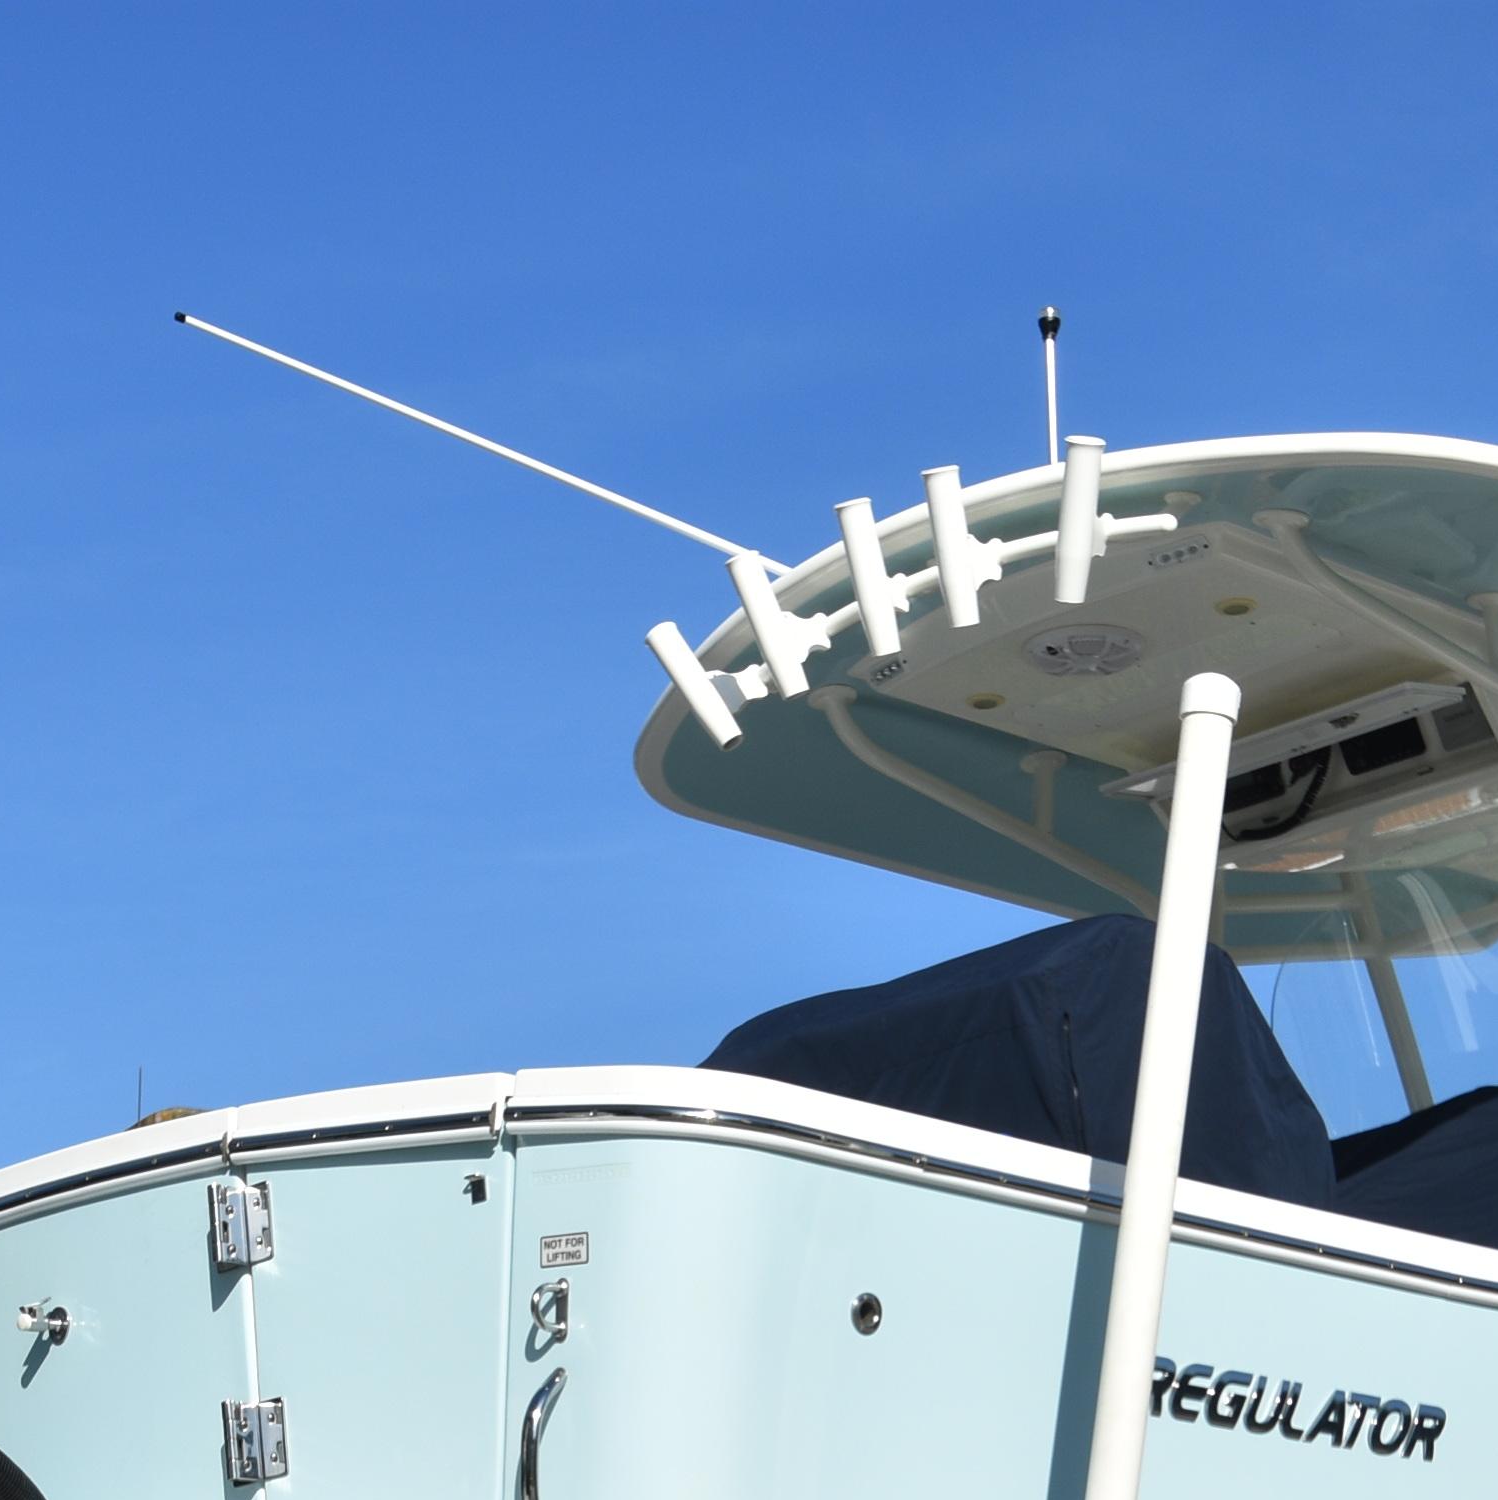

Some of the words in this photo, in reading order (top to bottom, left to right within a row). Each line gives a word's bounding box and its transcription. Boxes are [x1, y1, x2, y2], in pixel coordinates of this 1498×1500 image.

[544, 1239, 562, 1250] NOT
[565, 1236, 584, 1248] FOR
[546, 1250, 582, 1263] LIFTING
[1150, 1356, 1447, 1462] REGULATOR
